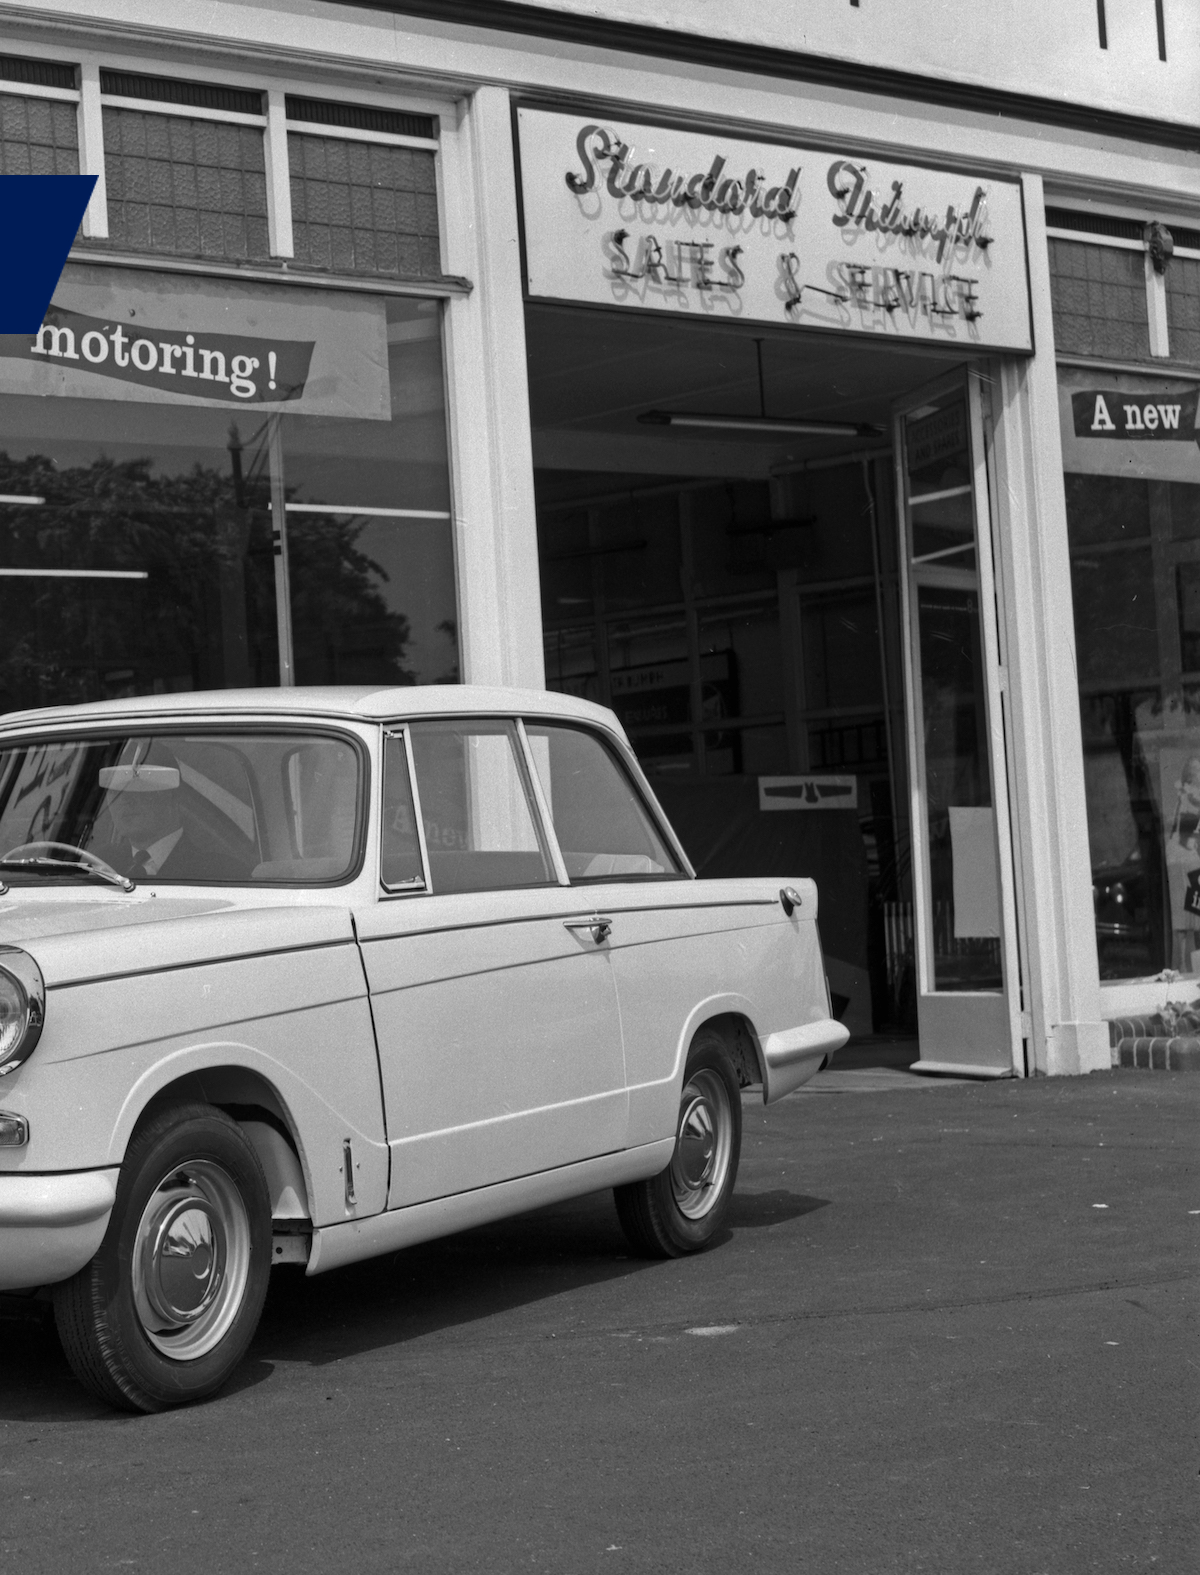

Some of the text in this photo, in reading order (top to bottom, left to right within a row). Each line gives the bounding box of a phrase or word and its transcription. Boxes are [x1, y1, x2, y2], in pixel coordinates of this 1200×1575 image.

[565, 125, 802, 223] Standard
[601, 229, 983, 322] SALES & SERVICE
[31, 323, 277, 398] motoring!
[1090, 394, 1182, 431] A new
